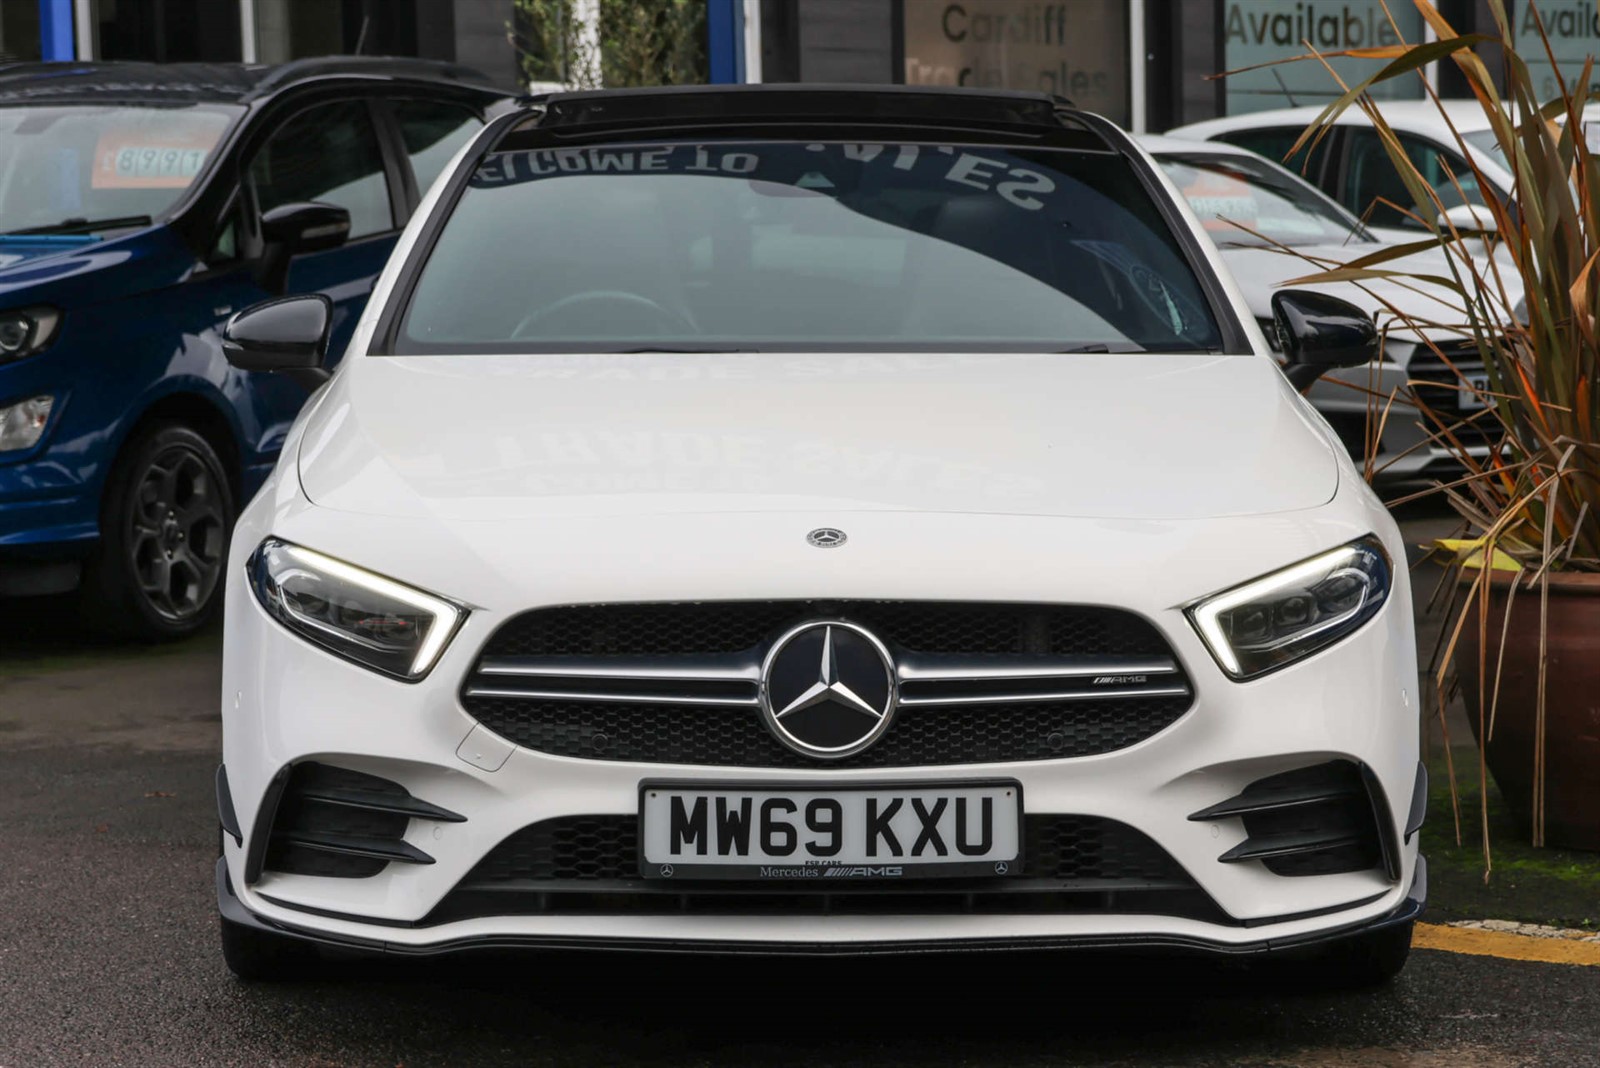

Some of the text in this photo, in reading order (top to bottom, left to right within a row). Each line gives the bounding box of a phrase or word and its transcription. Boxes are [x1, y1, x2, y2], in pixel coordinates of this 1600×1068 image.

[942, 4, 1066, 45] Cardiff
[1226, 3, 1397, 47] Available
[670, 796, 993, 857] MW69 KXU
[760, 867, 818, 877] Mercedes
